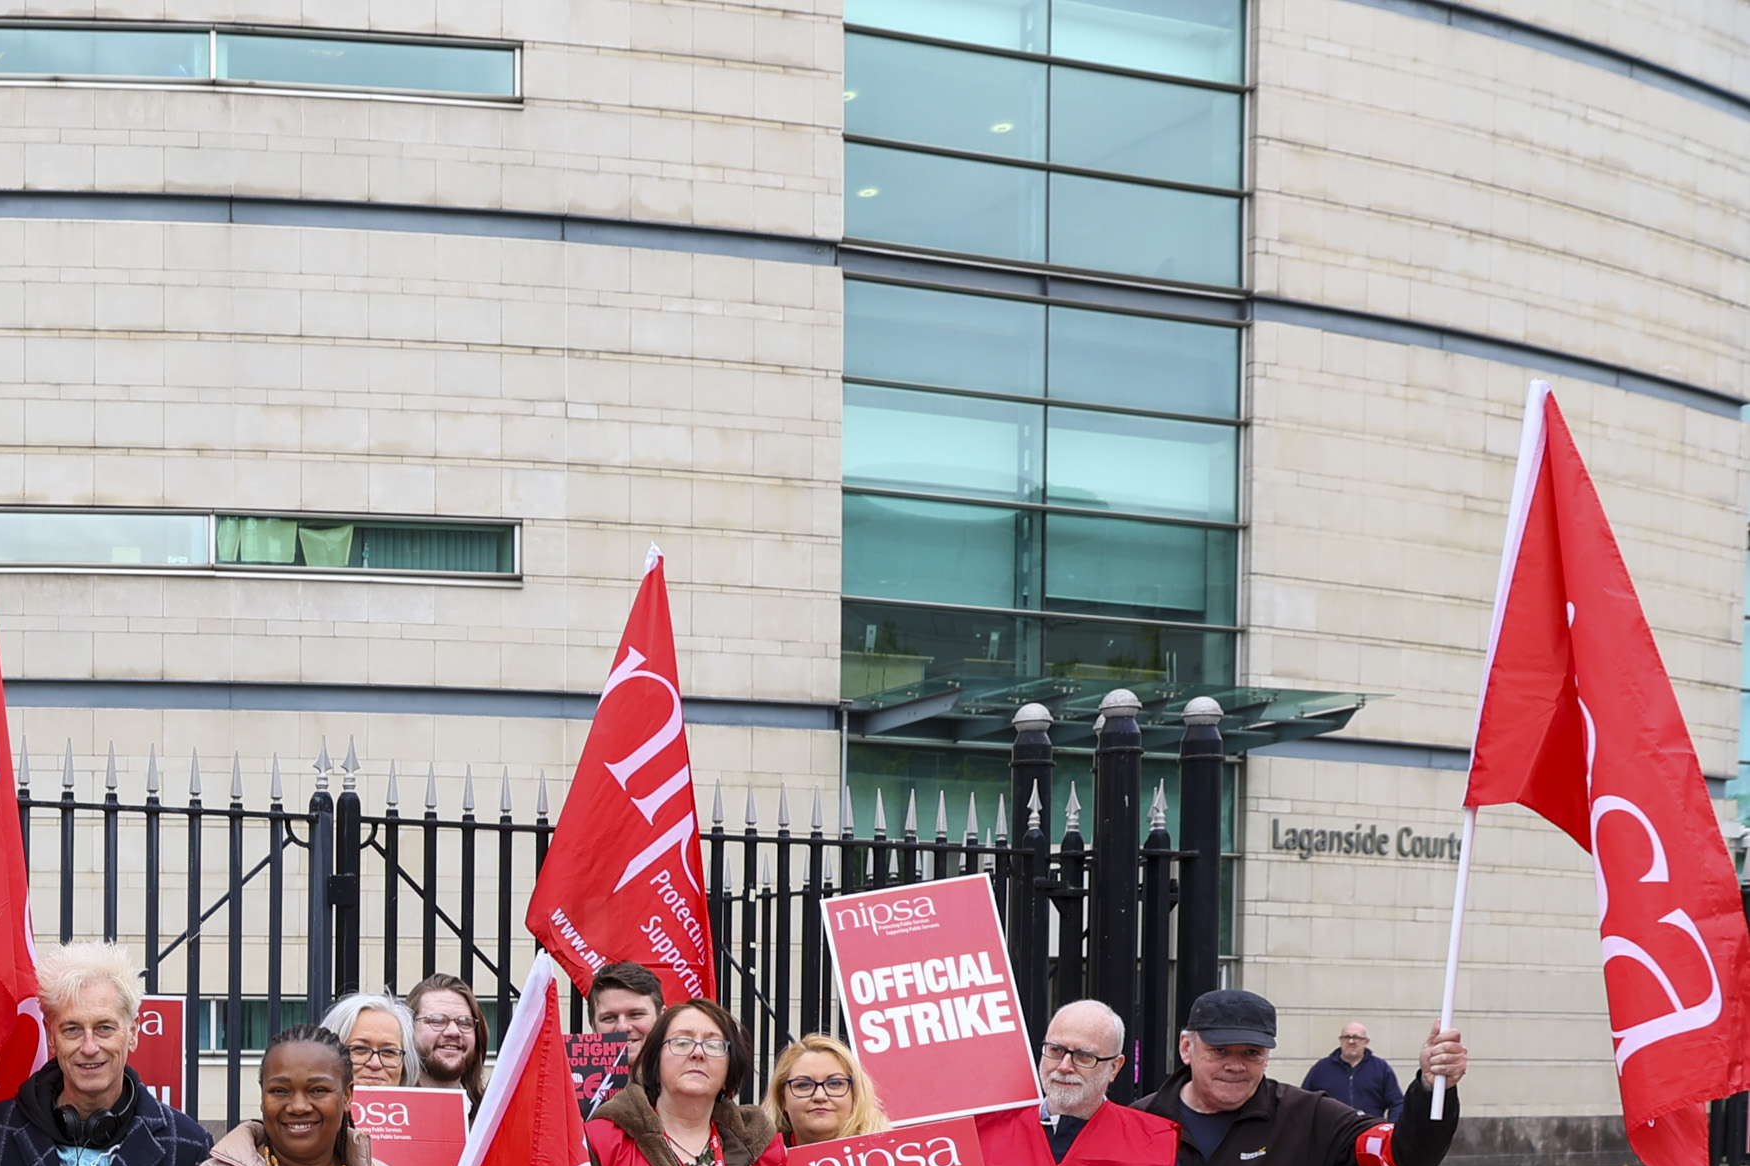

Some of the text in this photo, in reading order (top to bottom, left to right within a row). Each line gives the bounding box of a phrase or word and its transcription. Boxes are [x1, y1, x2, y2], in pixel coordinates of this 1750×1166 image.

[1272, 818, 1389, 860] Laganside
[835, 896, 937, 937] nipsa
[640, 915, 705, 1000] Supportin
[850, 951, 1004, 1005] OFFICIAL
[577, 1033, 603, 1042] YOU
[859, 990, 1016, 1053] STRIKE
[568, 1056, 588, 1067] OU
[572, 1042, 629, 1057] FIGHT
[604, 1065, 629, 1075] WIN
